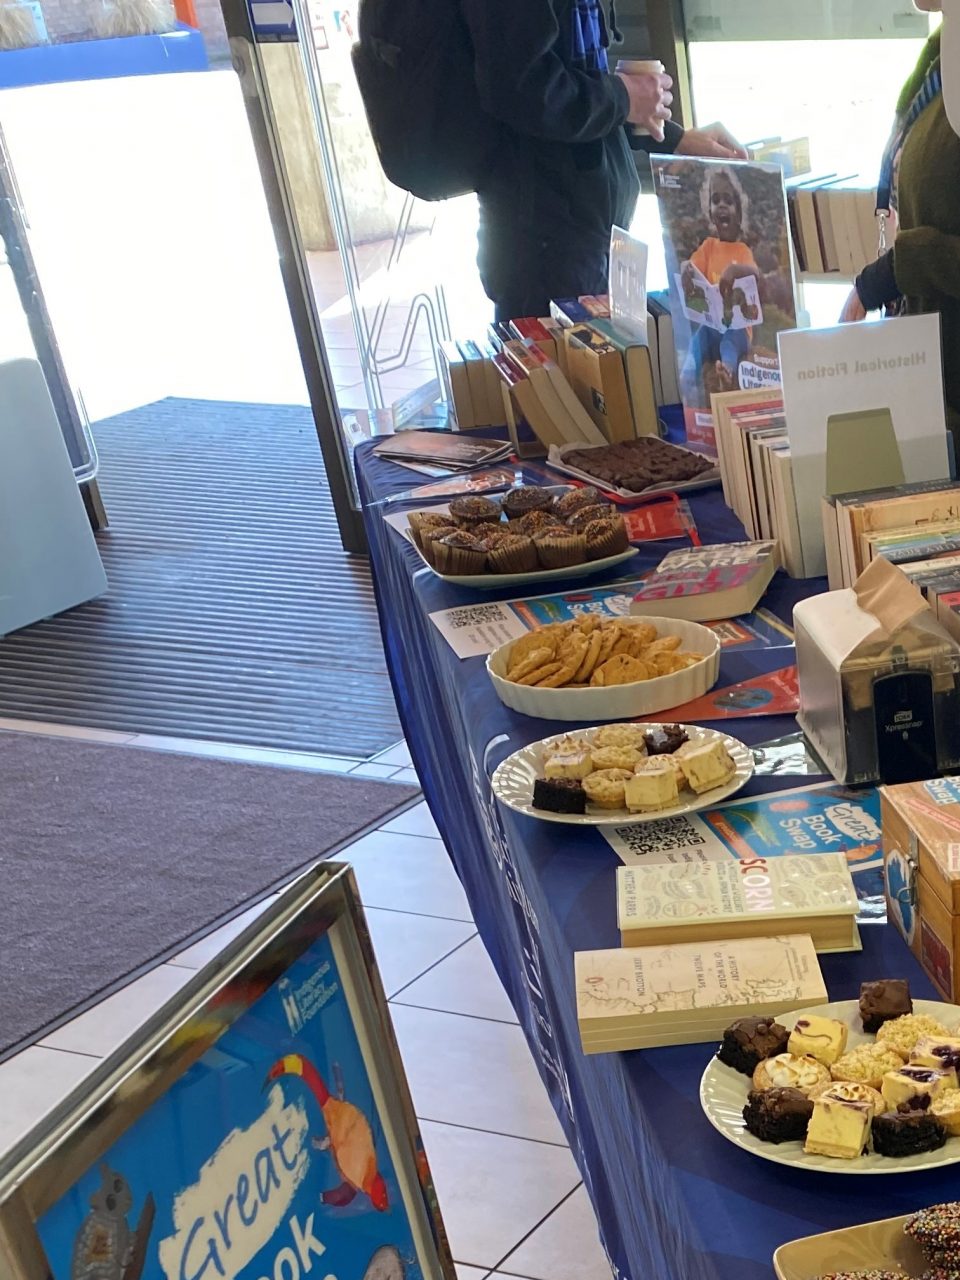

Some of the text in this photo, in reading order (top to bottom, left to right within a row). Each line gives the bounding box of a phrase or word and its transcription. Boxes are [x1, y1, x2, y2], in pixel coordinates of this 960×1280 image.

[779, 818, 817, 850] Swap
[801, 814, 842, 845] Book
[829, 805, 875, 840] Great
[739, 858, 776, 912] SCORN
